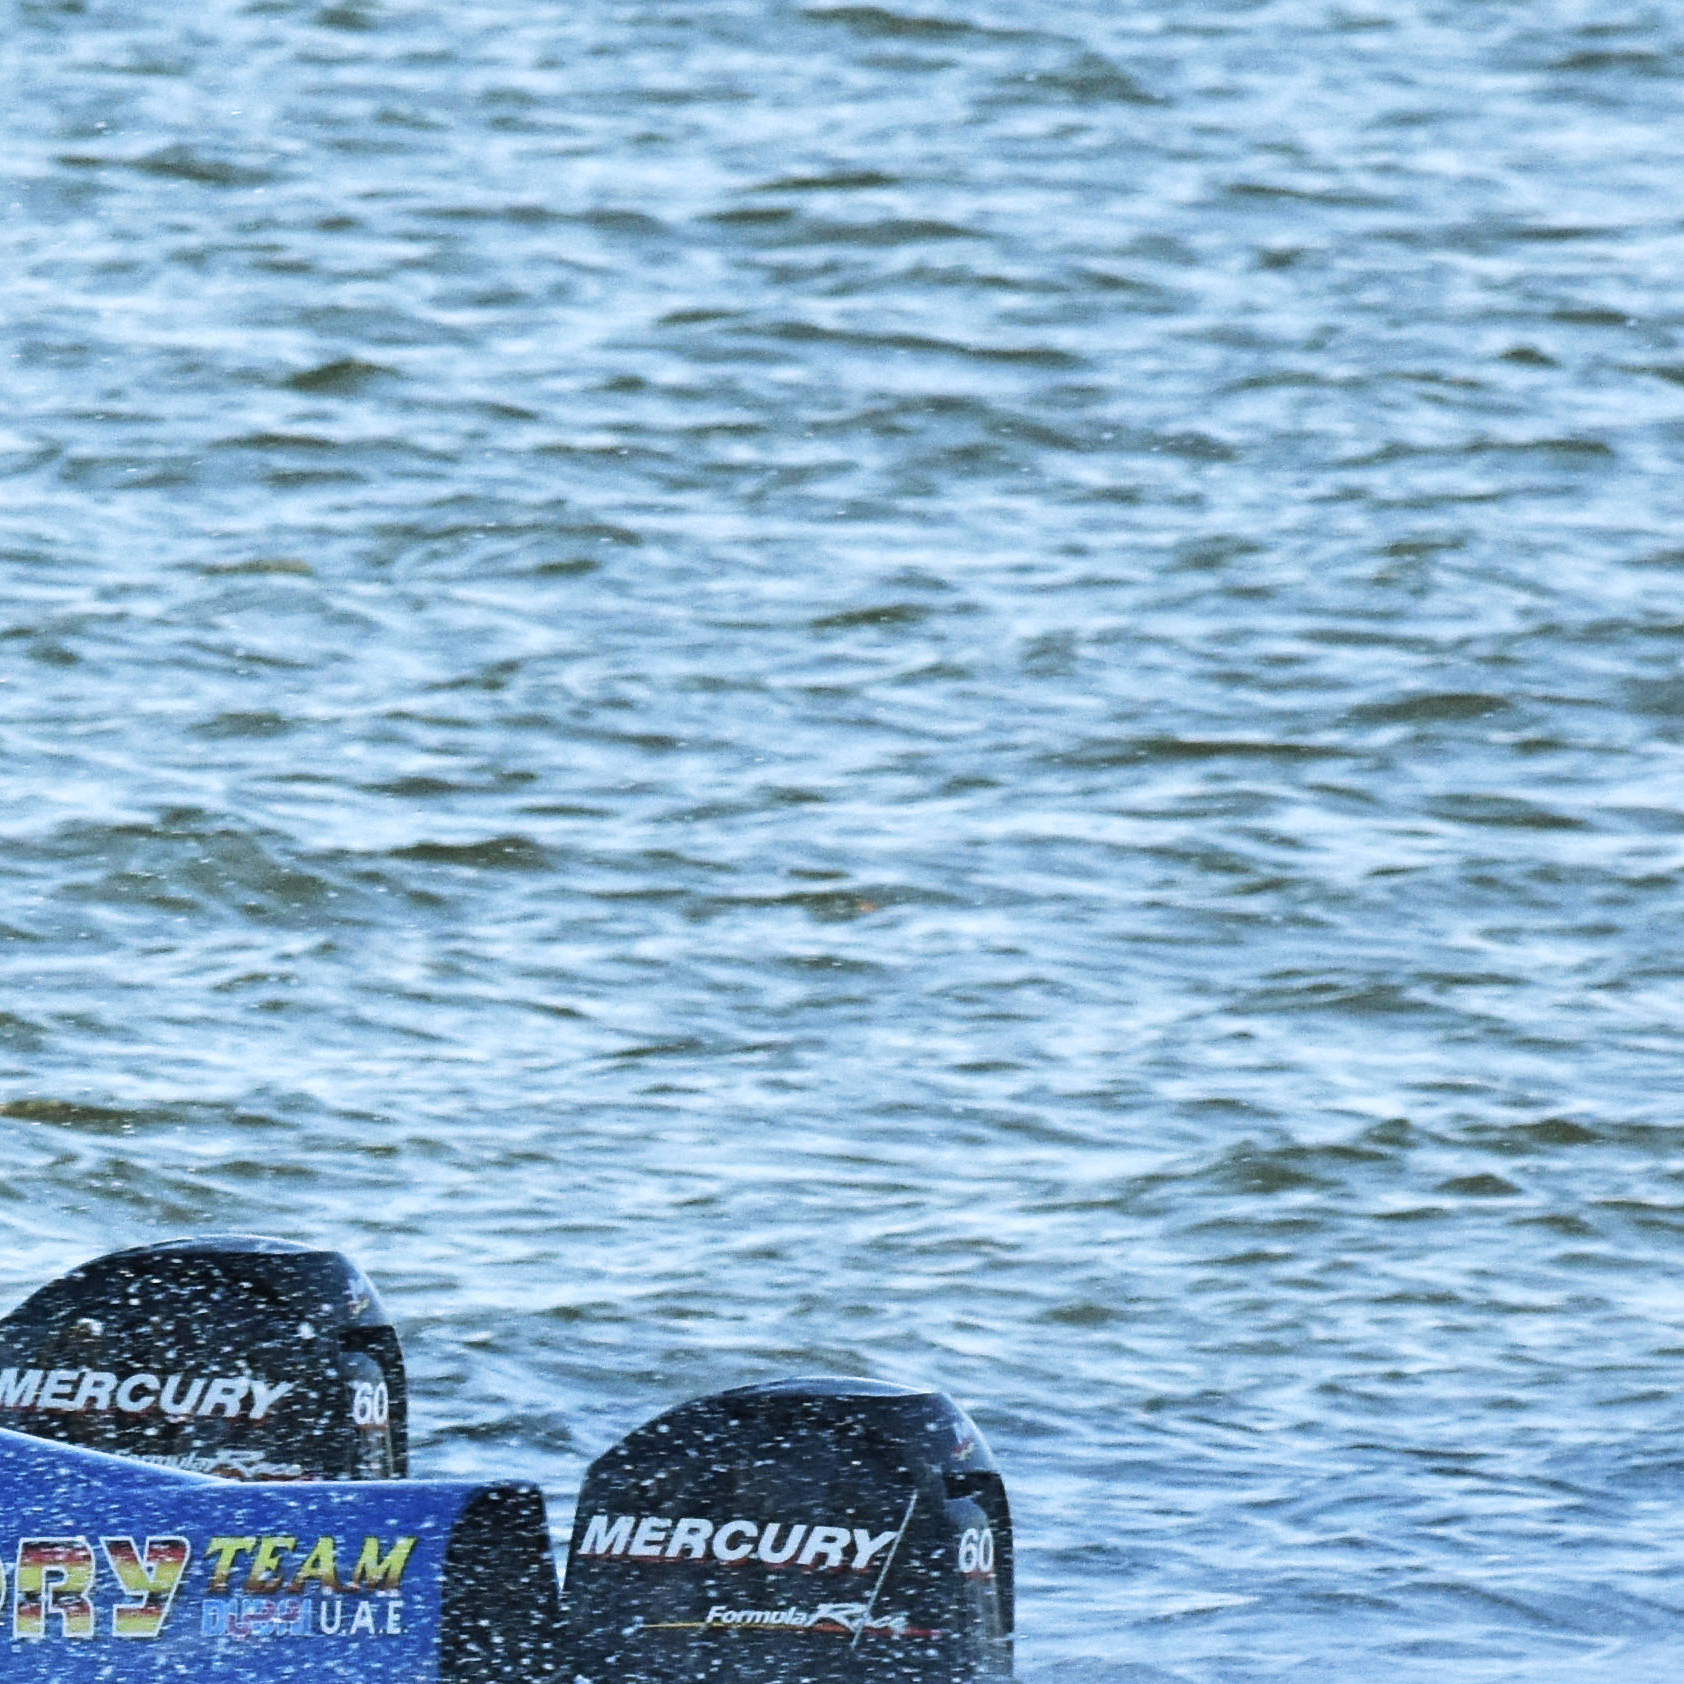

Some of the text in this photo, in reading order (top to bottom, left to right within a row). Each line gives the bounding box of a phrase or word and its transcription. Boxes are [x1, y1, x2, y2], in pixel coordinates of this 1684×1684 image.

[353, 1381, 389, 1426] 60
[205, 1535, 419, 1594] TEAM
[579, 1514, 899, 1571] MERCURY
[958, 1527, 994, 1574] 60
[705, 1604, 810, 1628] Formula
